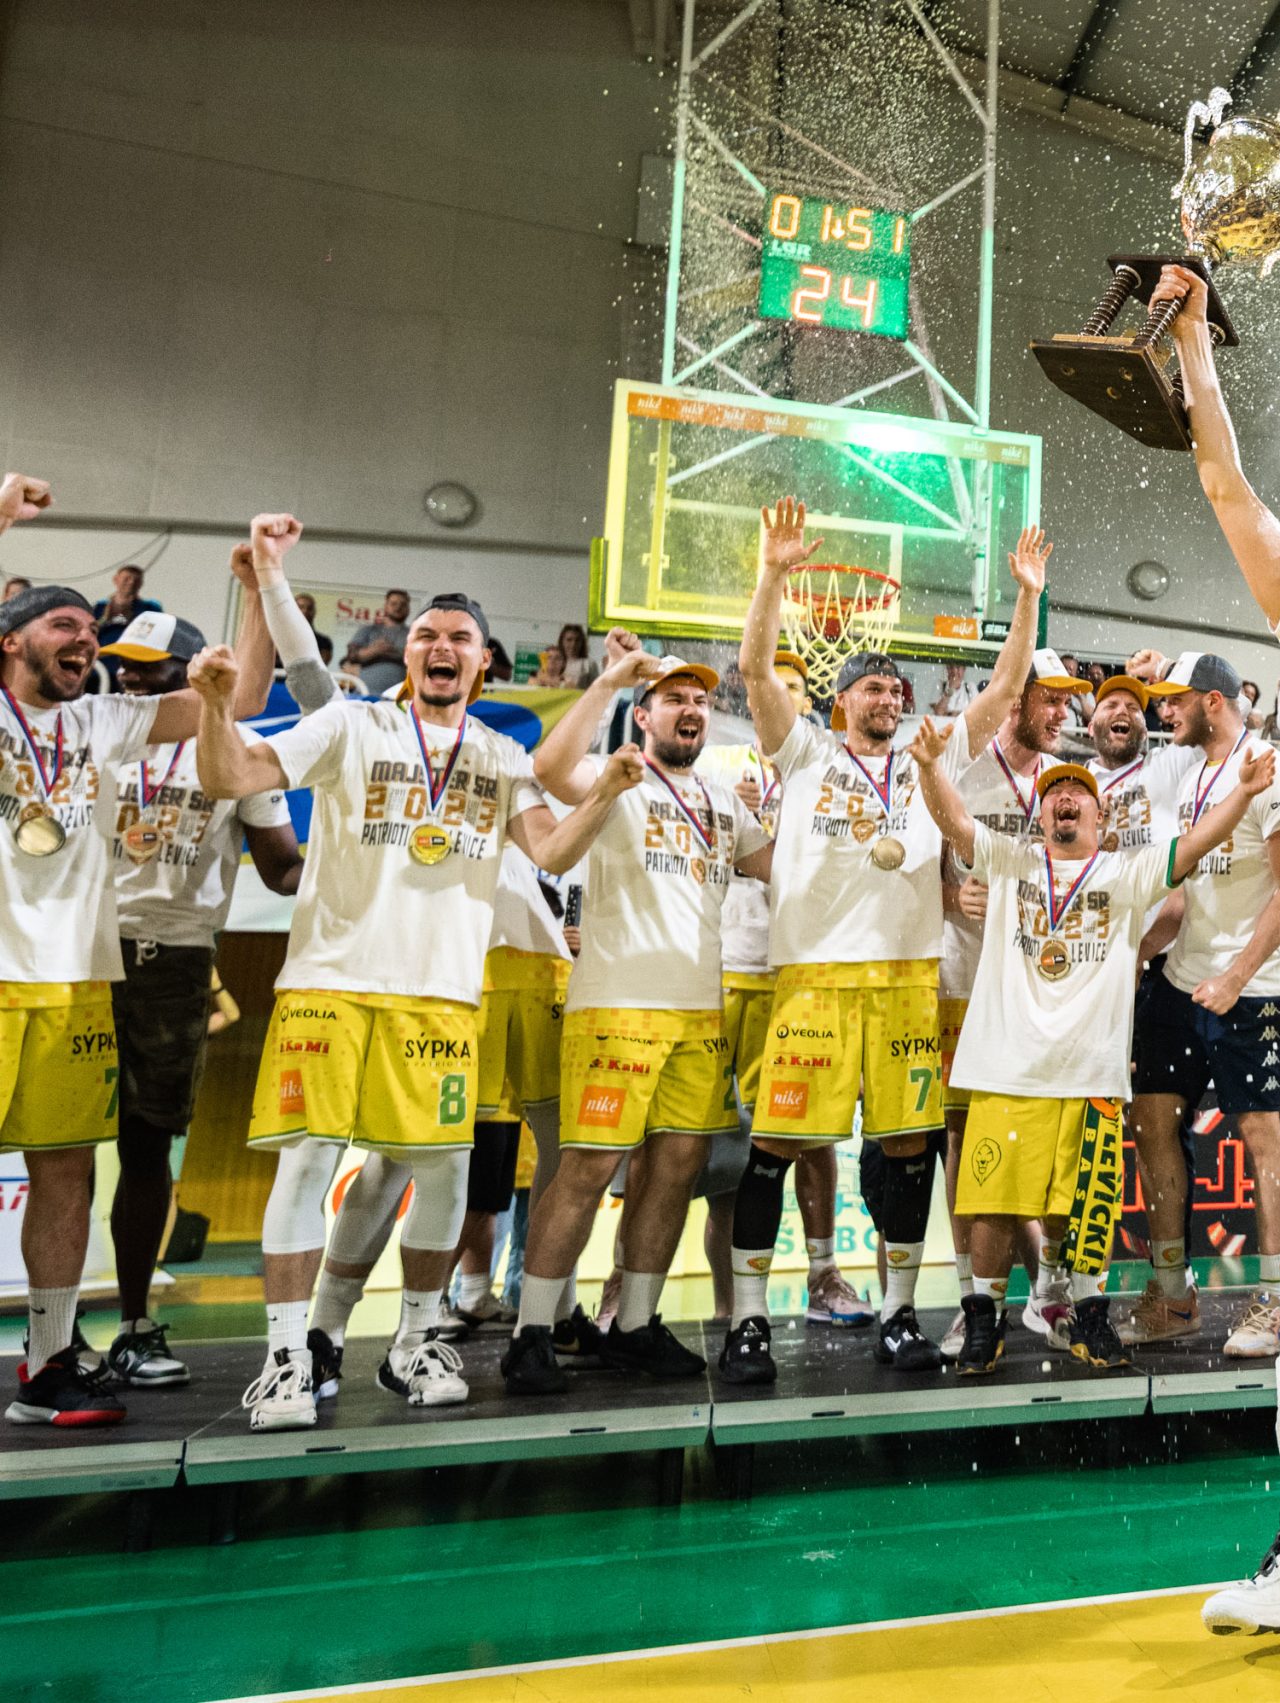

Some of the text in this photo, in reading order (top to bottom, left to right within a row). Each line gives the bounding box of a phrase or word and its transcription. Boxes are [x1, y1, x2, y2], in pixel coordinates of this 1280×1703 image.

[791, 264, 878, 328] 24
[473, 774, 498, 801] SR
[364, 784, 498, 834] 2023
[361, 821, 410, 847] PATRIOTI
[645, 851, 688, 877] PATRIOTI
[1071, 942, 1107, 963] LEVICE
[290, 1008, 337, 1020] VEOLIA
[72, 1026, 117, 1055] SÝPK
[405, 1032, 471, 1059] SÝPKA
[791, 1029, 834, 1039] VEOLIA
[790, 1055, 832, 1068] KaMi
[439, 1074, 466, 1126] 8
[586, 1096, 619, 1113] niké
[774, 1089, 803, 1106] niké
